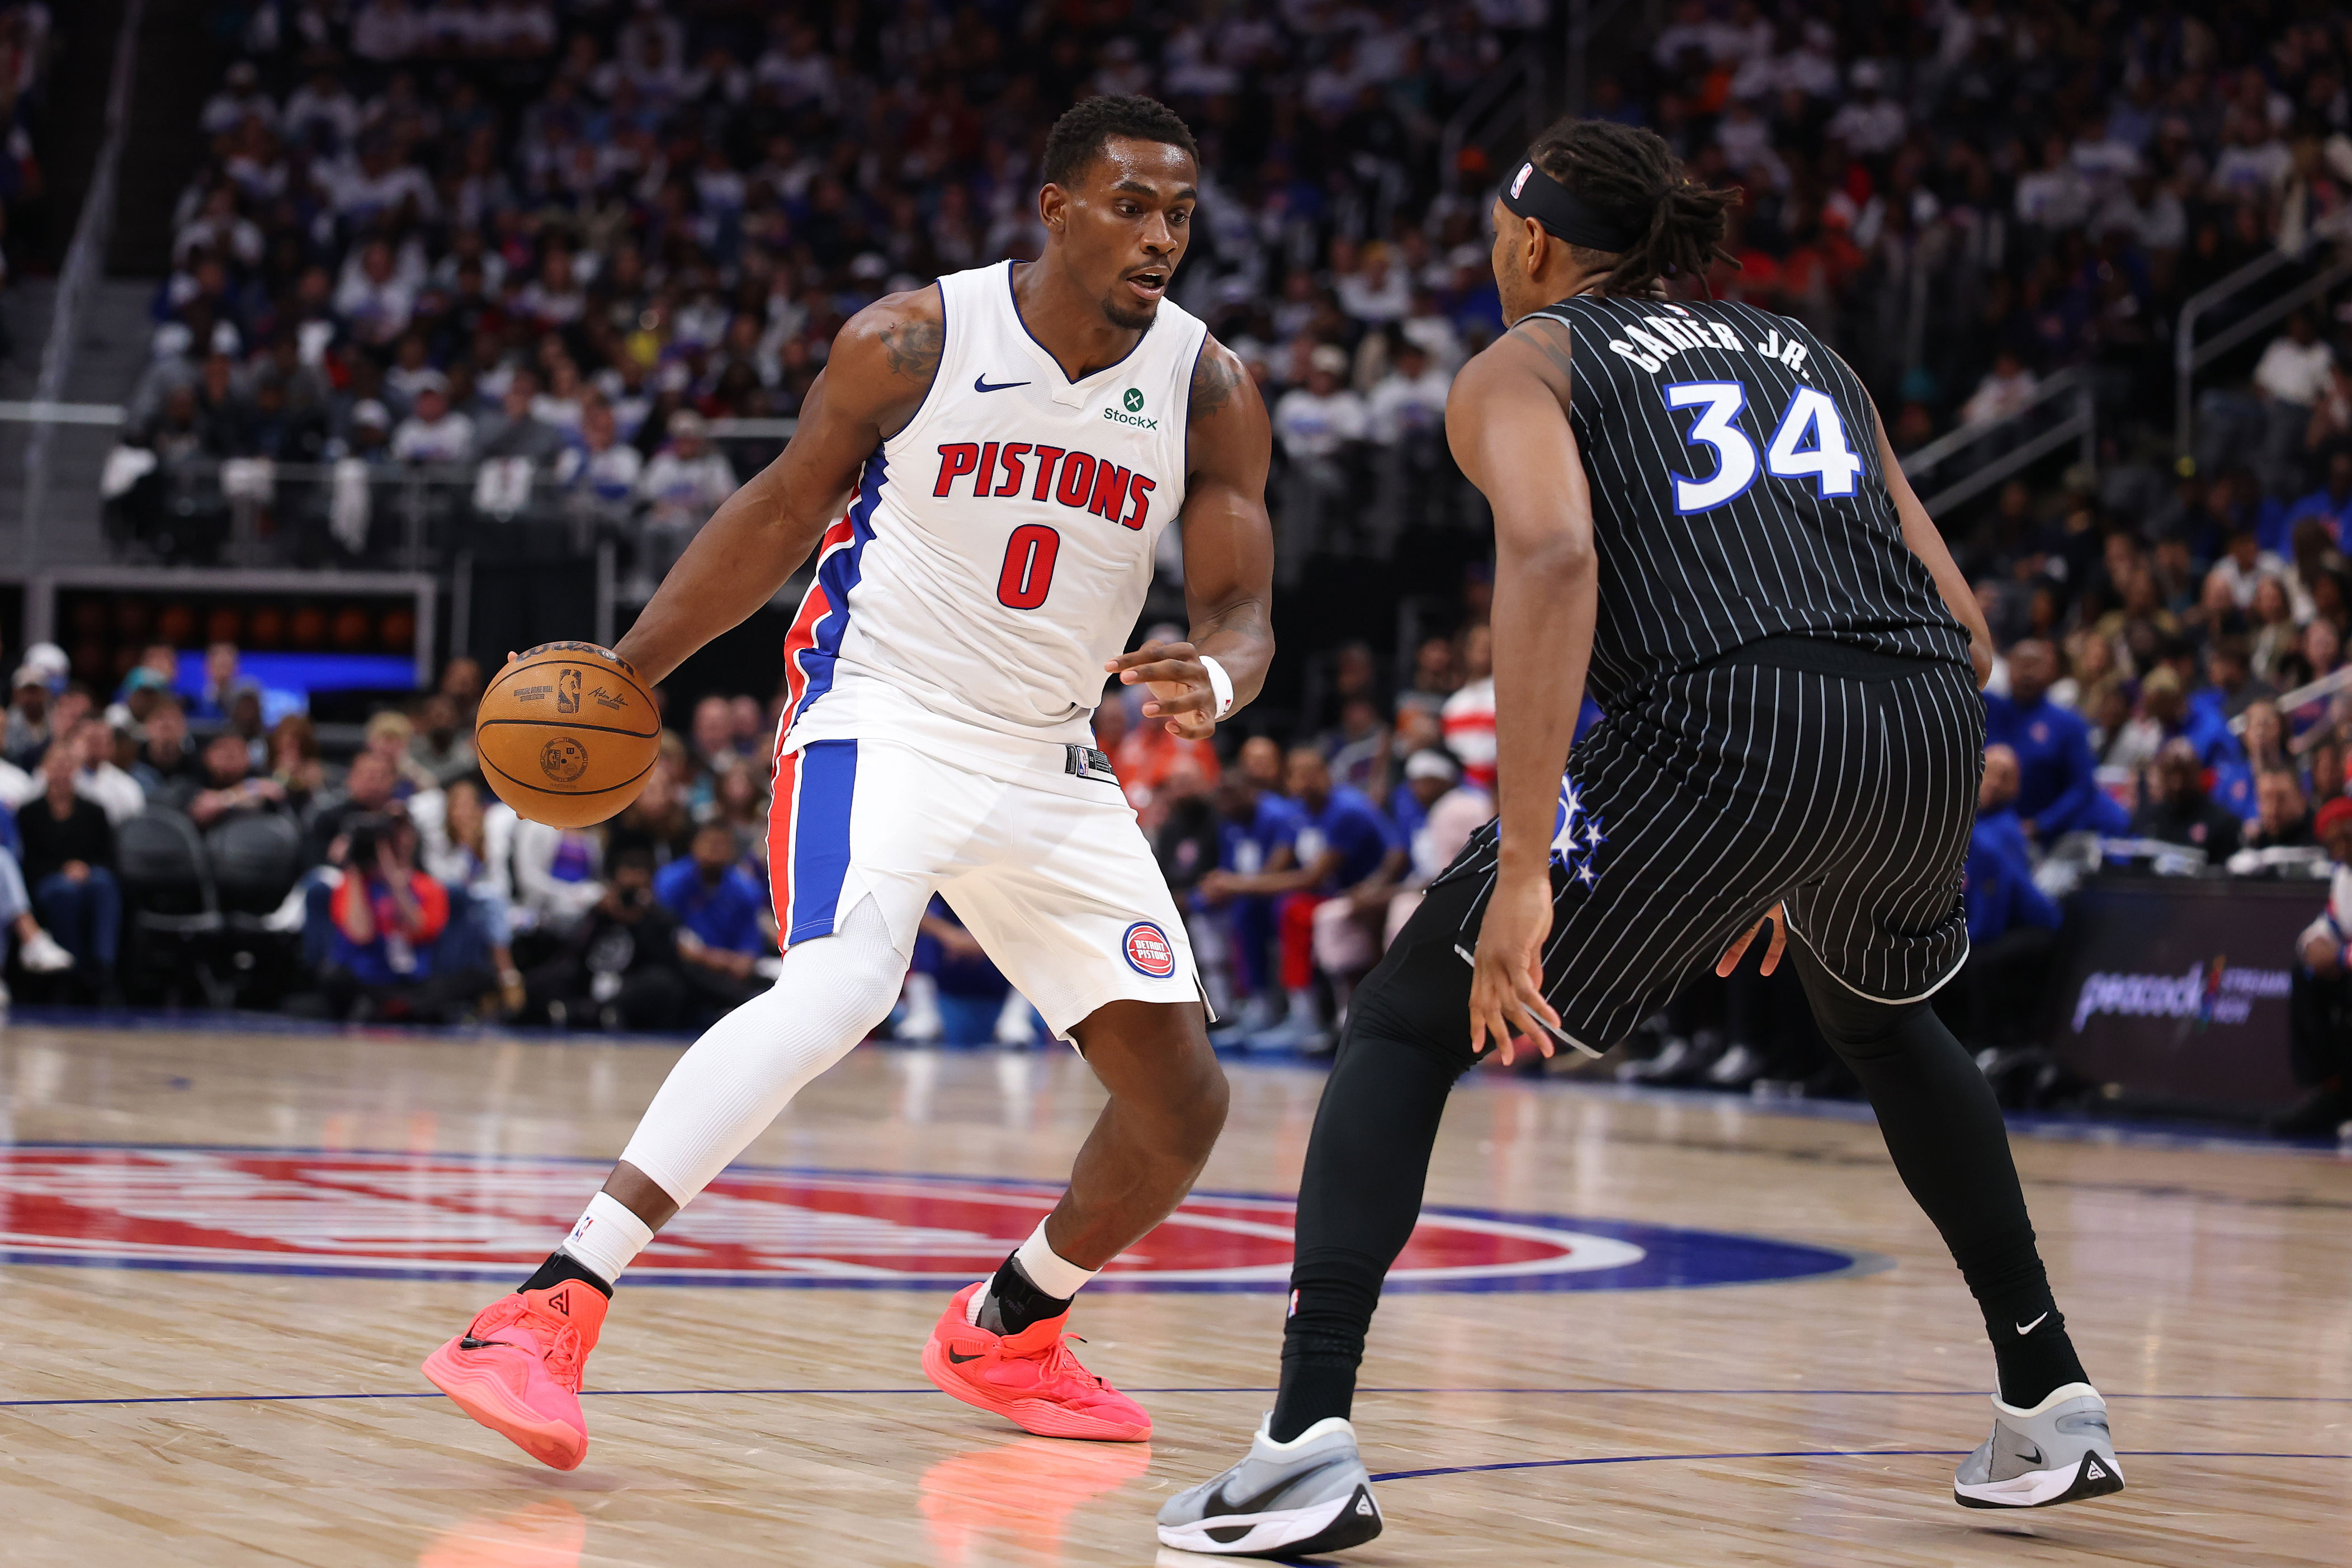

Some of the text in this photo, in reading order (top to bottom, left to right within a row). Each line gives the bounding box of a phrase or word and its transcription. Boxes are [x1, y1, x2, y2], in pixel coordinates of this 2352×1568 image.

[1609, 316, 1811, 379] CARTER JR.
[1103, 407, 1158, 431] StockX
[1663, 380, 1865, 516] 34
[932, 441, 1156, 531] PISTONS
[996, 523, 1061, 611] 0
[1134, 939, 1165, 952] DETROIT
[1136, 950, 1168, 961] PISTONS
